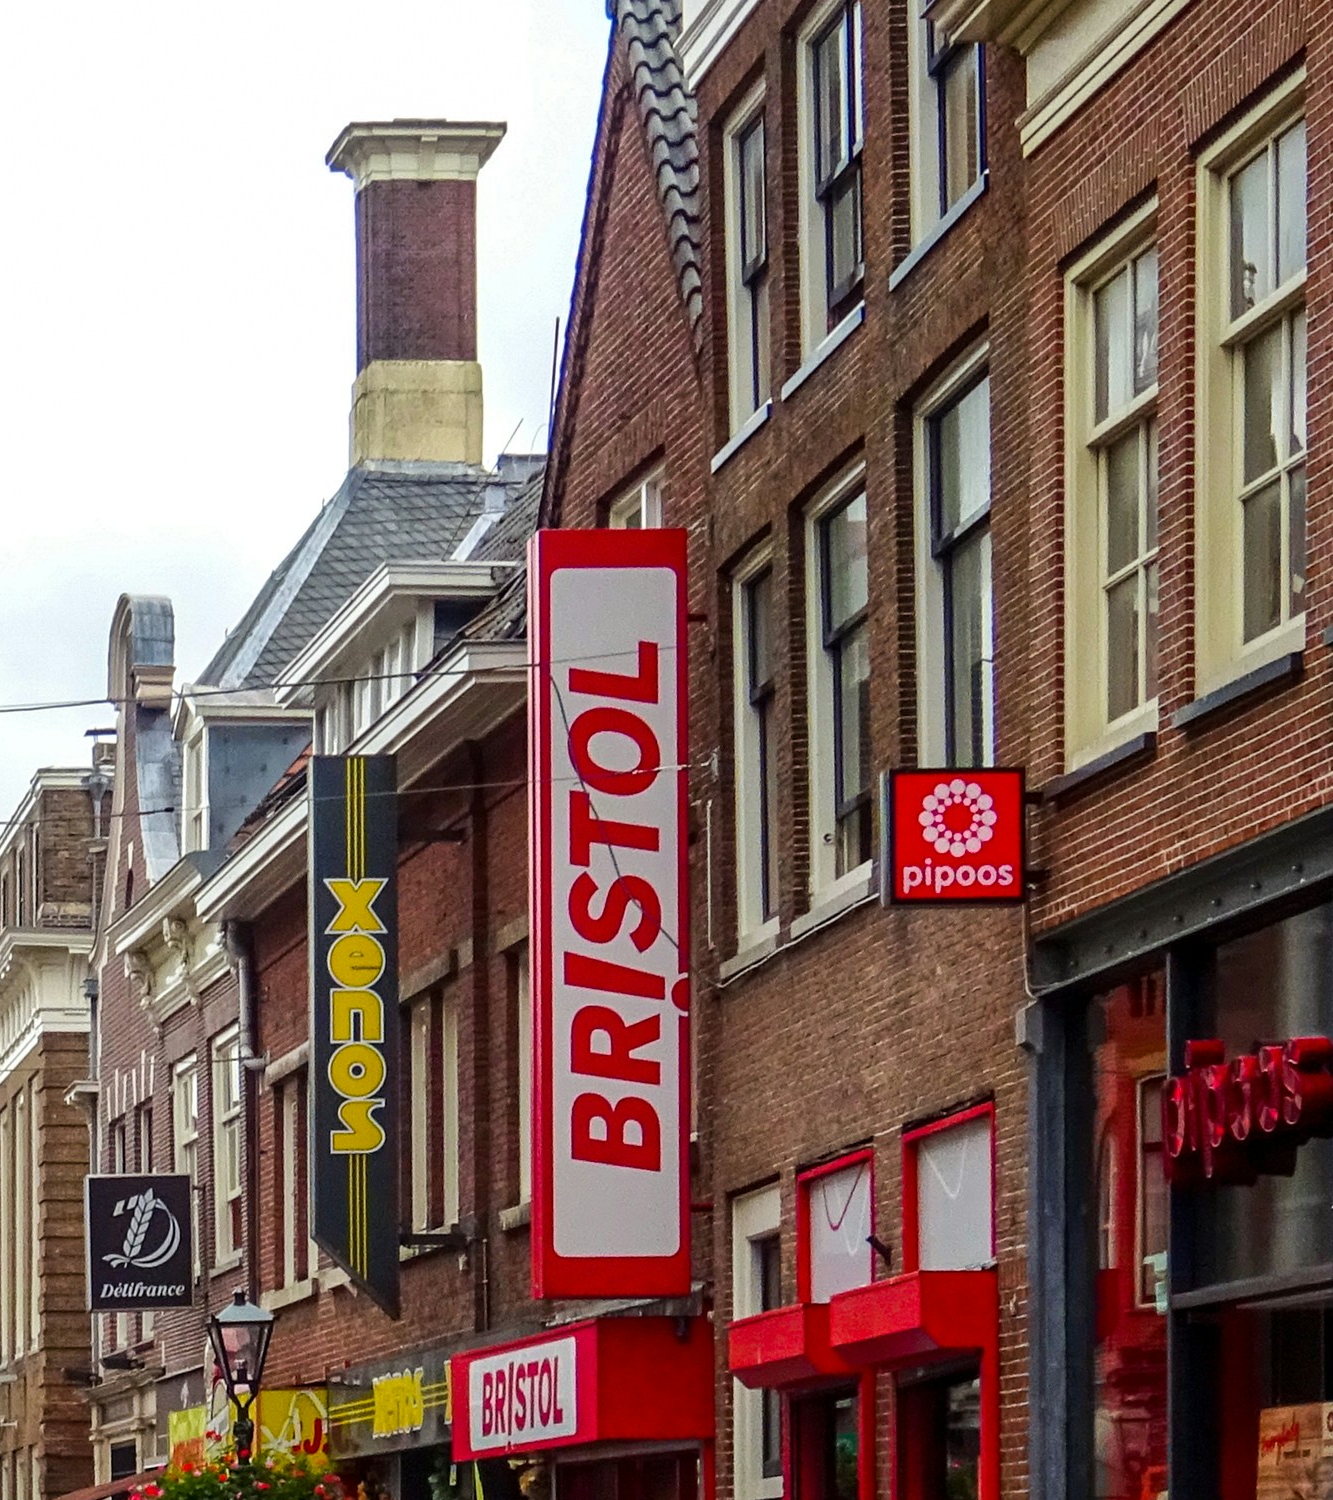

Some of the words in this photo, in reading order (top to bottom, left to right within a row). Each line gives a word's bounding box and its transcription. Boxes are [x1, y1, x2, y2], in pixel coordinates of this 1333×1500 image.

[902, 857, 1014, 894] pipoos
[564, 640, 666, 1173] BRISTOL
[100, 1281, 185, 1299] Délifrance
[482, 1355, 563, 1437] BRISTOL
